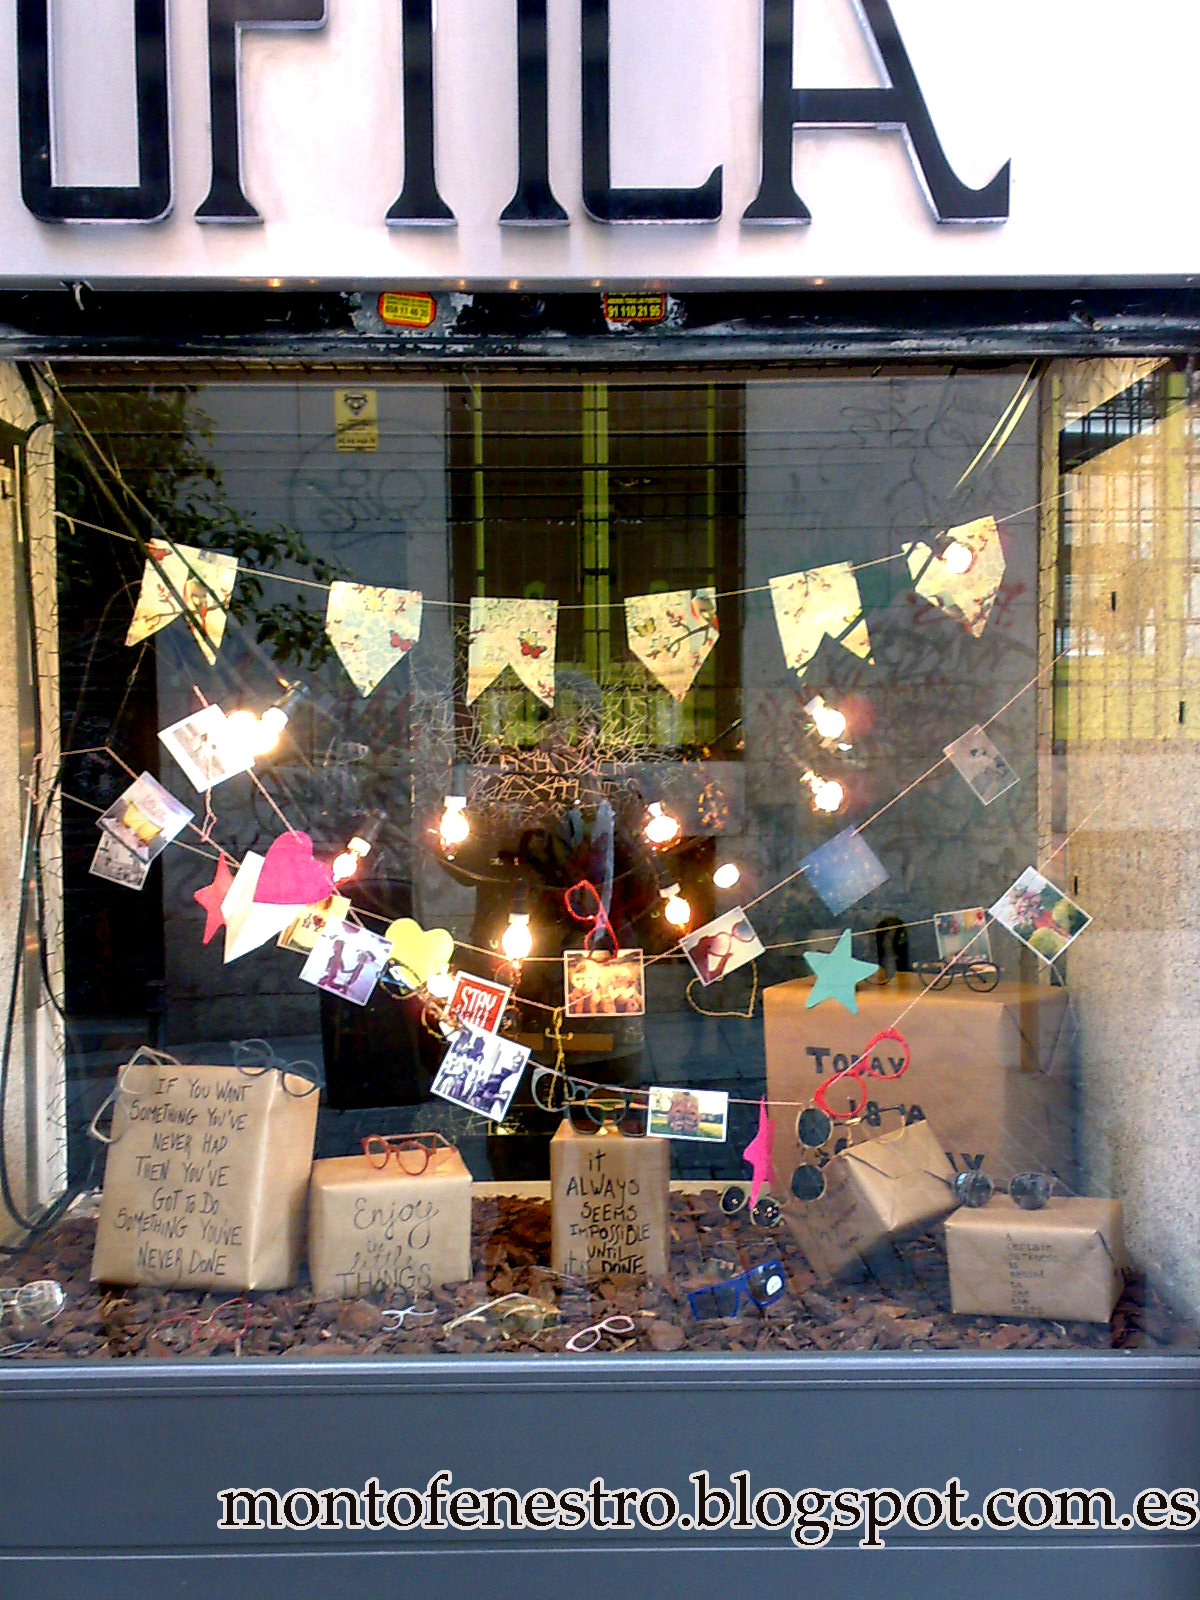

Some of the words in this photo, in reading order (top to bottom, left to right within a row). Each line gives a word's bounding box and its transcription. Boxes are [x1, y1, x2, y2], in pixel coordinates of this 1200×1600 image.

[461, 985, 498, 1014] STAY
[154, 1077, 179, 1095] IF
[188, 1079, 210, 1098] YOU
[216, 1084, 252, 1102] WANT
[129, 1101, 199, 1127] SOMETHING
[207, 1107, 248, 1131] YOU'VE
[152, 1132, 192, 1159] NEVER
[203, 1134, 228, 1153] HAD
[135, 1155, 171, 1182] THEN
[182, 1160, 230, 1187] YOU'VE
[152, 1187, 183, 1212] GOT
[566, 1174, 640, 1209] ALWAYS
[113, 1207, 189, 1239] SOMETHING
[200, 1219, 242, 1246] YOU'VE
[353, 1197, 440, 1250] Enjoy
[580, 1201, 638, 1223] SEEMS
[569, 1222, 651, 1246] IMPOSSIBLE
[138, 1241, 183, 1277] NEVER
[188, 1249, 227, 1276] DONE
[601, 1255, 647, 1275] DONE
